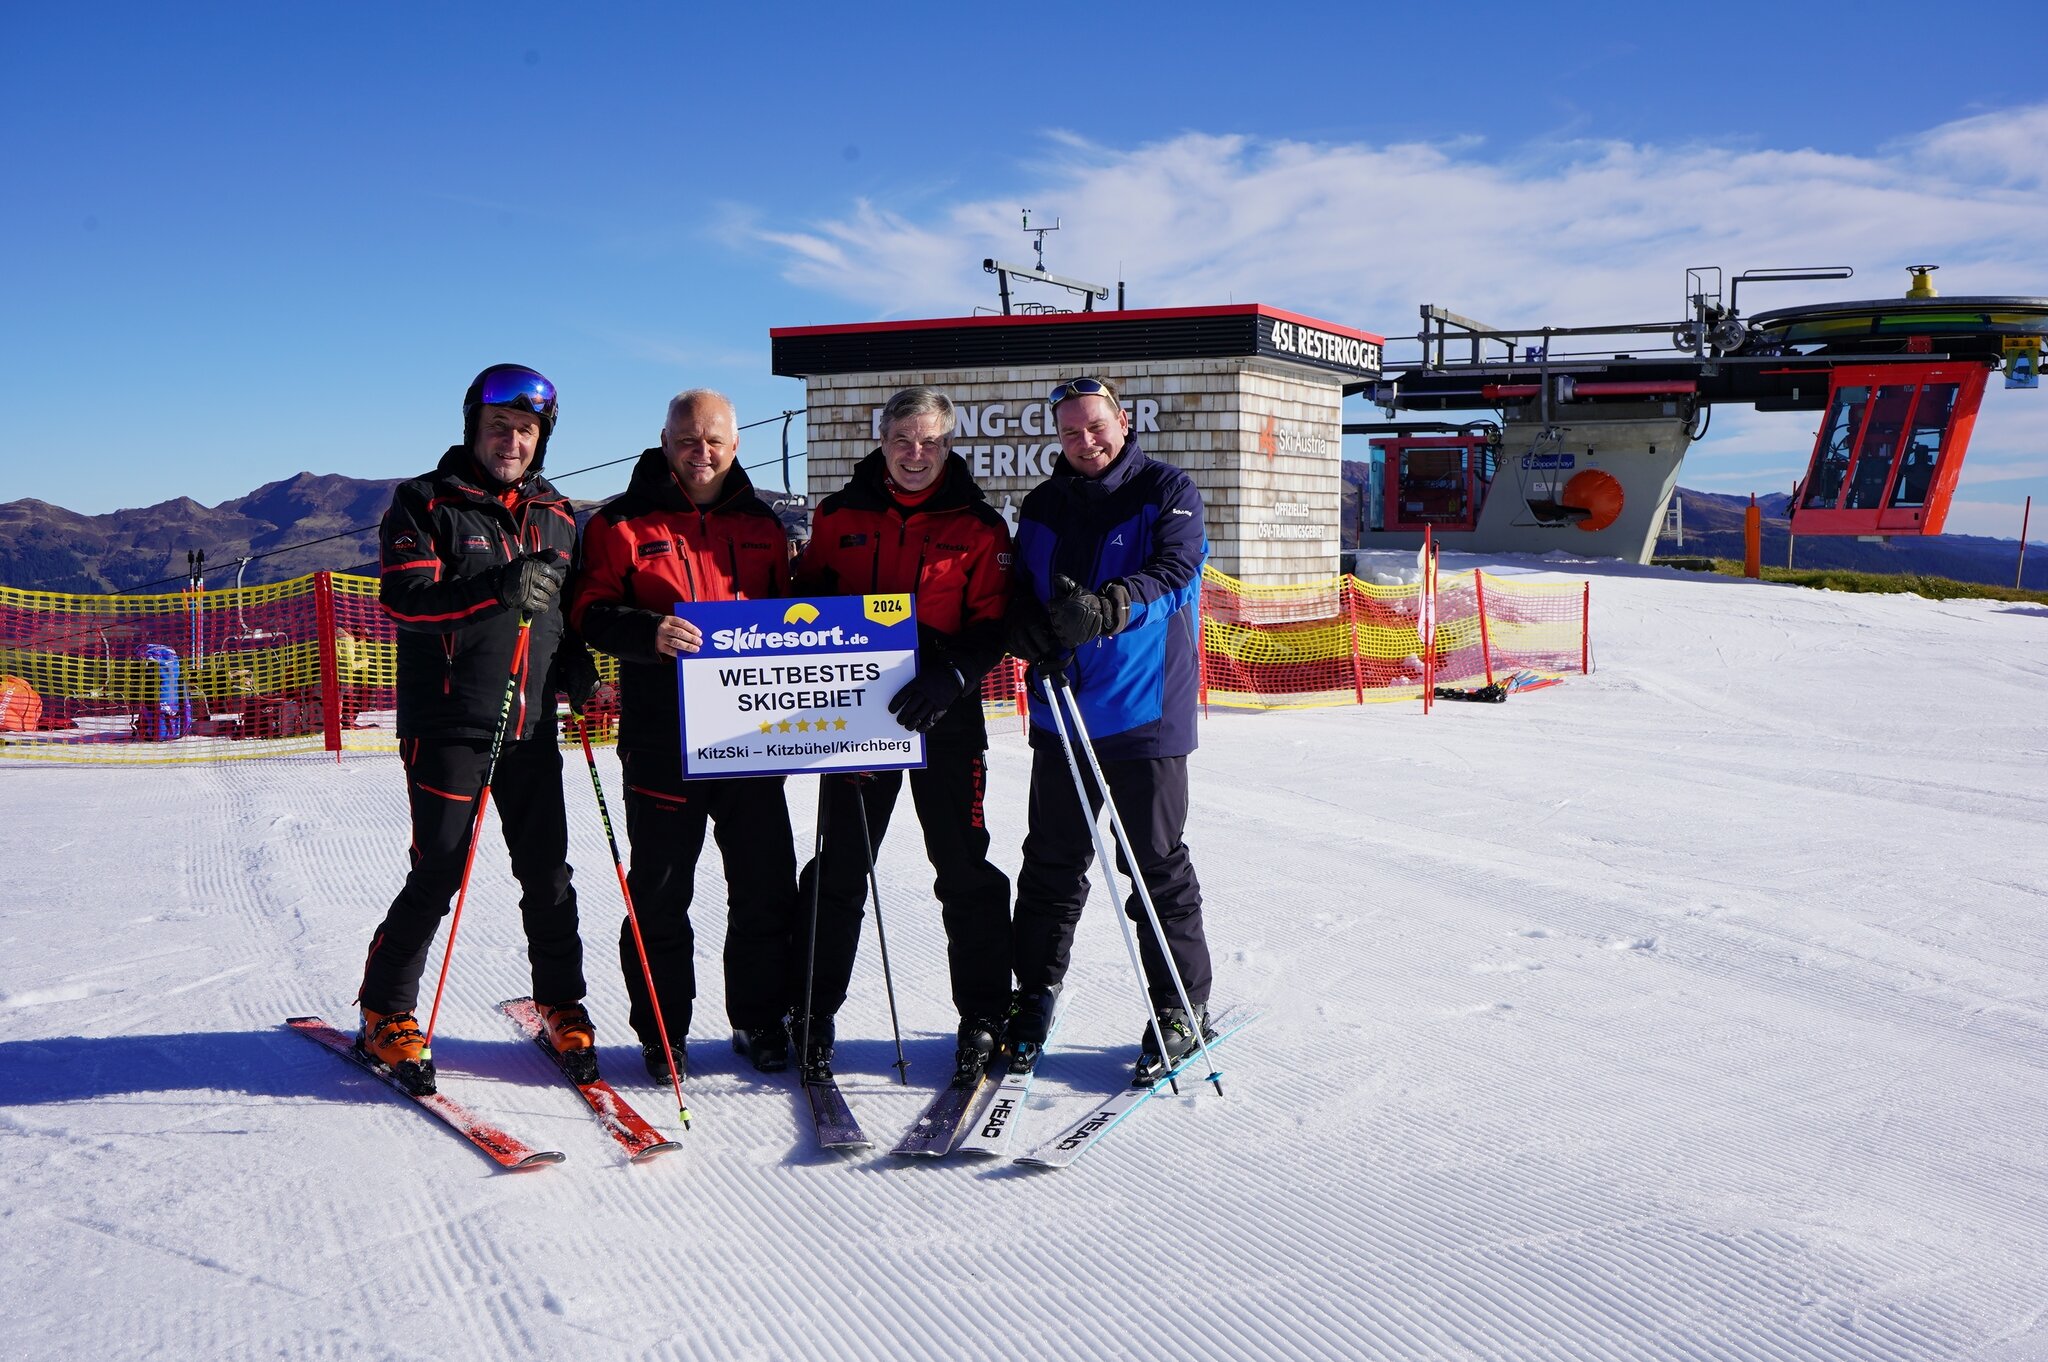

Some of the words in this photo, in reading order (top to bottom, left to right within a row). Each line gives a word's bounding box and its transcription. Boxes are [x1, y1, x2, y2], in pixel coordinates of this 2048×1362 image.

[1271, 321, 1296, 353] 4SL
[1298, 327, 1380, 371] RESTERKOGEL
[1279, 429, 1293, 450] Ski
[1296, 434, 1326, 455] Austria
[1275, 502, 1310, 517] OFFIZIELLES
[1258, 520, 1326, 539] ÖSV-TRAININGSGEBIET
[873, 600, 903, 613] 2024
[711, 623, 869, 654] Skiresort.de
[719, 663, 881, 687] WELTBESTES
[500, 679, 516, 719] LEKI
[738, 689, 866, 712] SKIGEBIET
[697, 745, 749, 760] KitzSki
[766, 739, 911, 757] Kitzbühel/Kirchberg
[981, 1098, 1016, 1139] HEAD
[1055, 1111, 1117, 1151] HEAD
